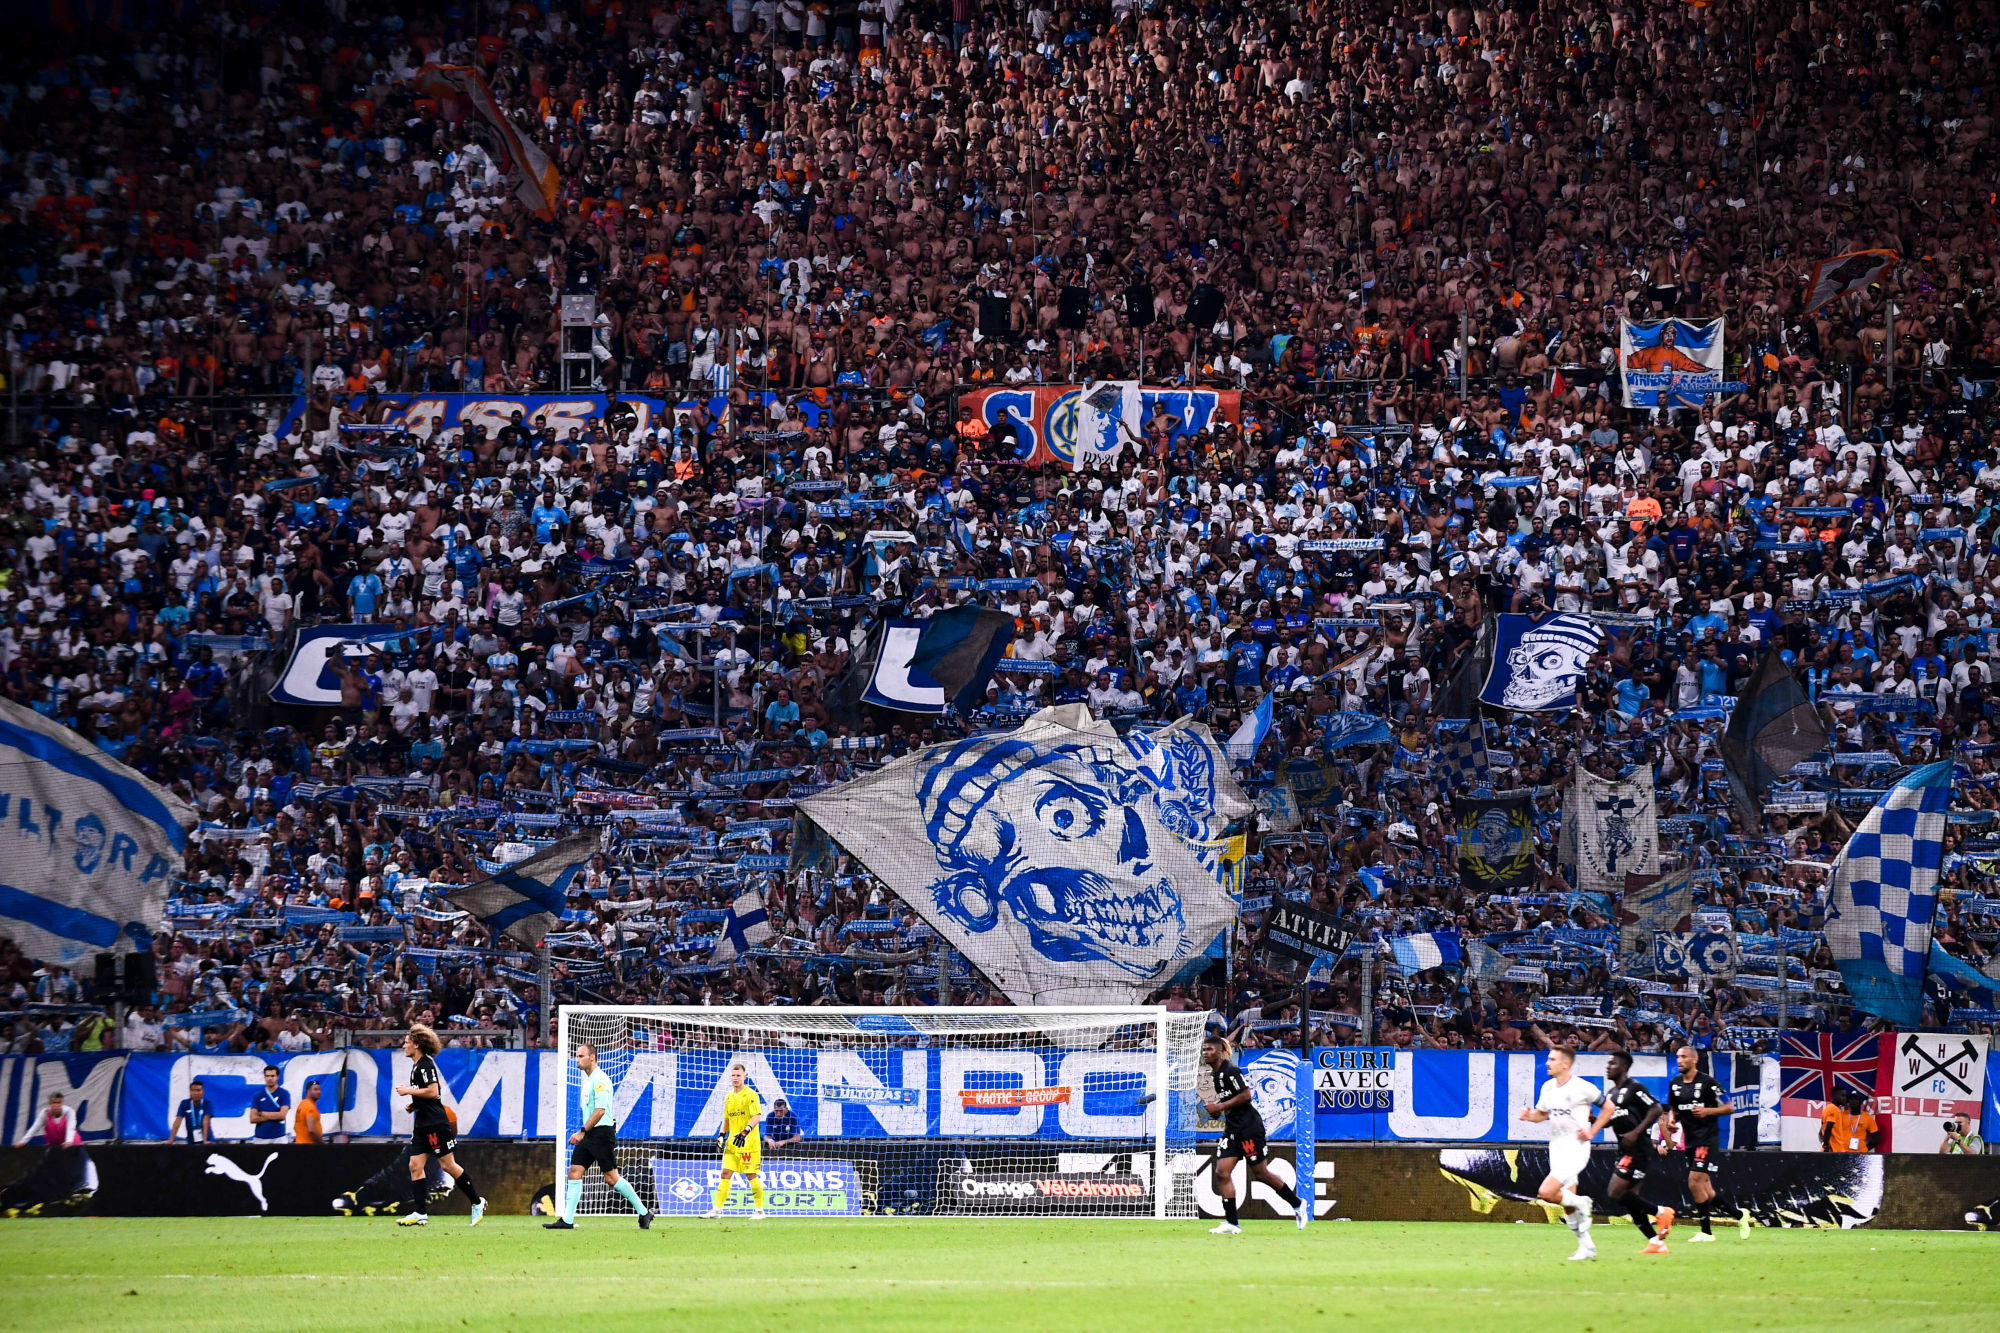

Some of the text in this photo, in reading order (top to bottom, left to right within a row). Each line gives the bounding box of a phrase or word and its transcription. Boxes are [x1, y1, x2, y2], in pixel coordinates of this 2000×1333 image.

[1319, 1049, 1391, 1070] CHRI
[1908, 1043, 1969, 1079] W H U
[1319, 1070, 1390, 1088] AVEC
[1932, 1079, 1946, 1093] FC
[1025, 1090, 1059, 1103] GROUP
[1318, 1090, 1391, 1108] NOUS
[707, 1170, 845, 1190] PARIONS
[961, 1177, 1143, 1198] Orange Vélodrome
